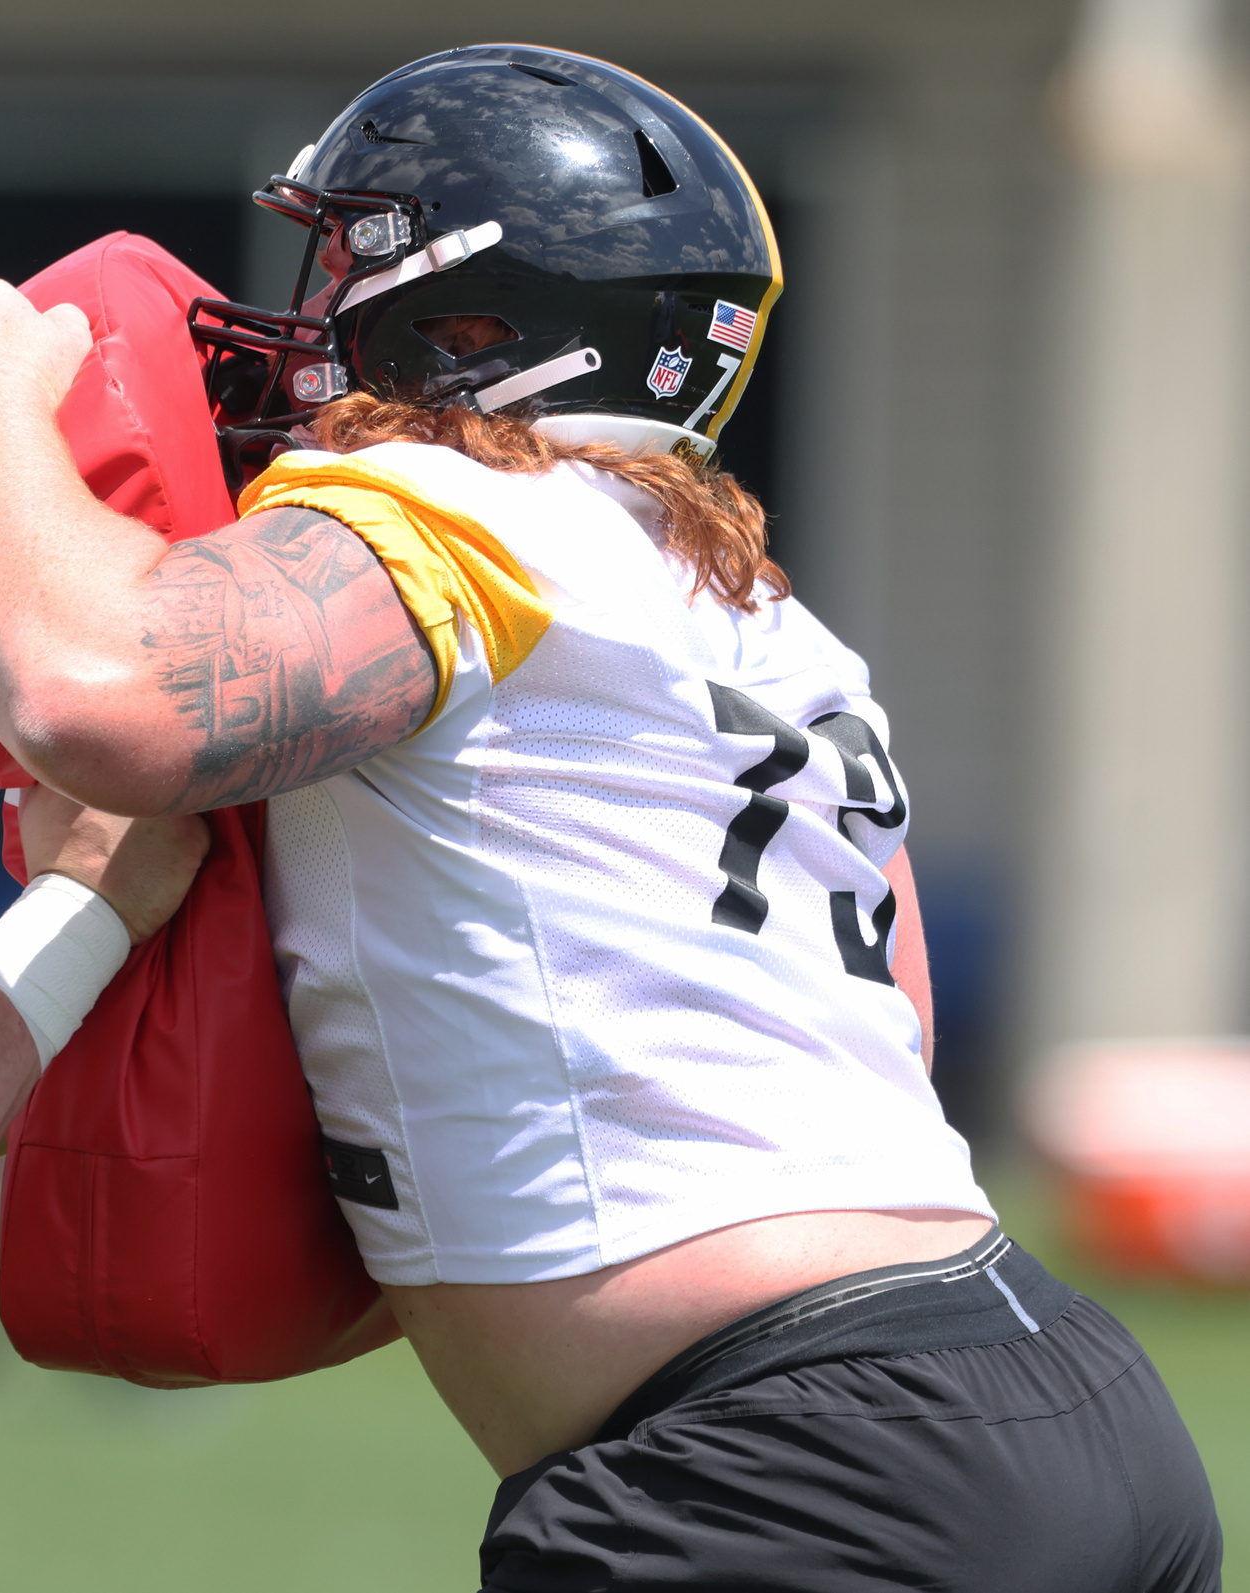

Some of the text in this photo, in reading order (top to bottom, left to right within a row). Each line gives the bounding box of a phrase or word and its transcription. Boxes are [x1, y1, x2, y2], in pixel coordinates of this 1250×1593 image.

[652, 366, 679, 392] NFL
[682, 353, 742, 430] 7
[705, 679, 907, 989] 79
